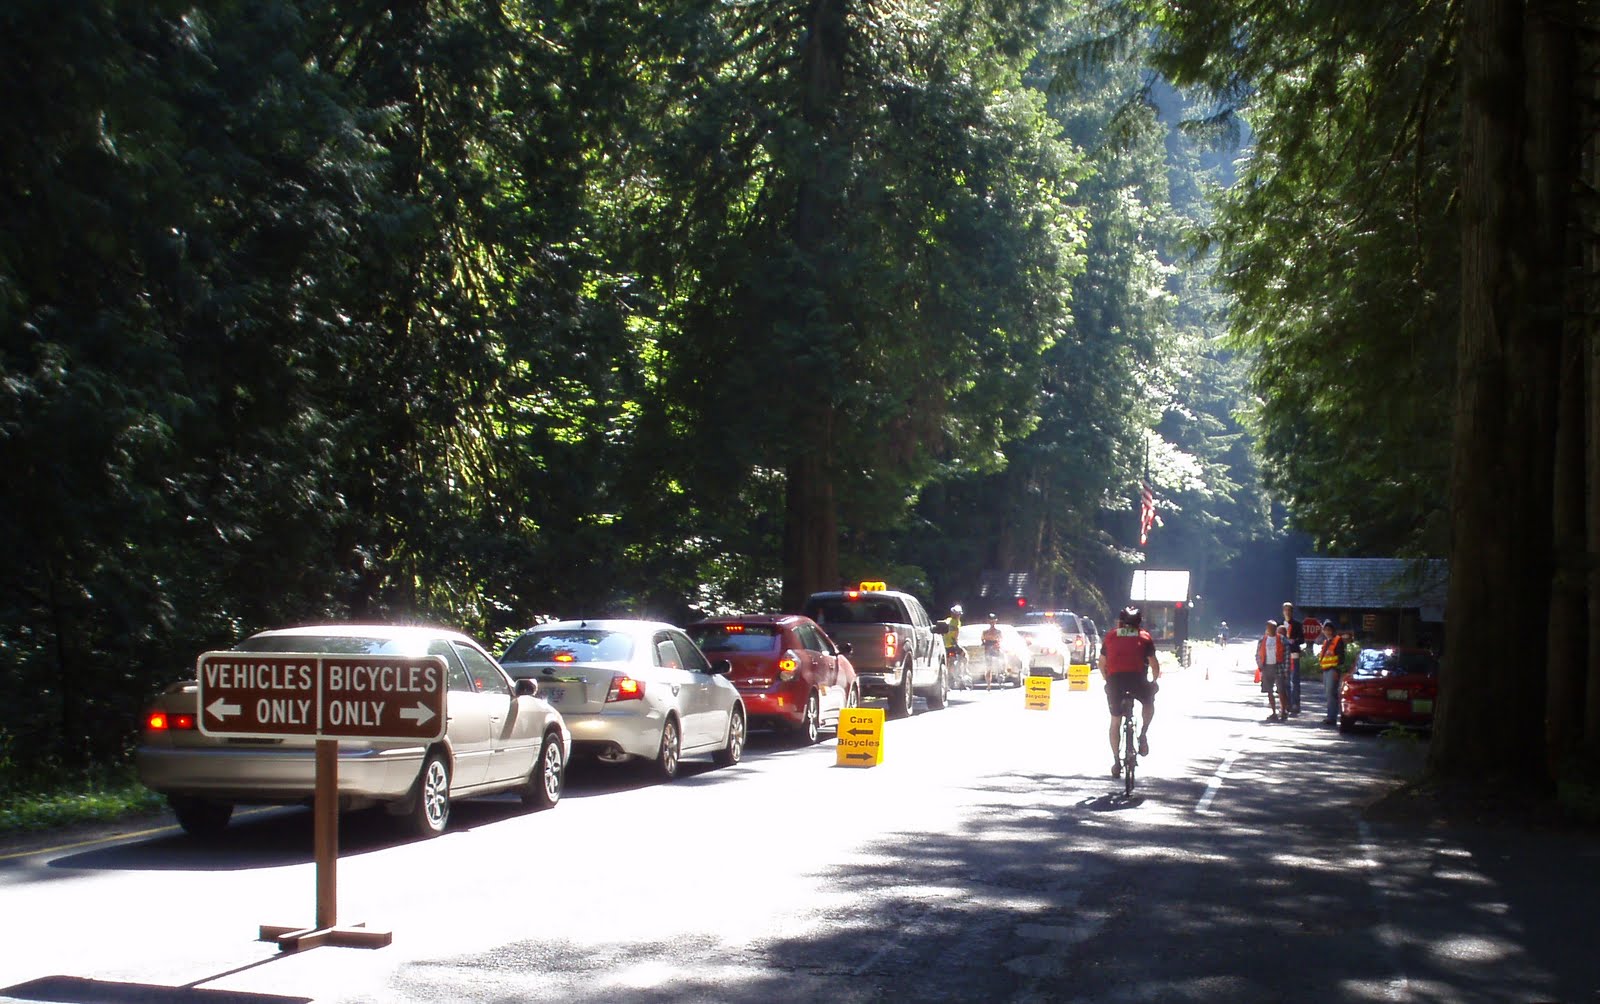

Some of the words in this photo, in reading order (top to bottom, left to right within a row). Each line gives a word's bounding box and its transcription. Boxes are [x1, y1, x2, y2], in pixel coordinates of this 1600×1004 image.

[1302, 625, 1320, 634] STOP
[204, 663, 312, 690] VEHICLES
[328, 666, 438, 693] BICYCLES
[256, 698, 311, 725] ONLY
[329, 700, 385, 726] ONLY
[849, 716, 874, 724] Cars
[838, 738, 880, 748] Bicycles
